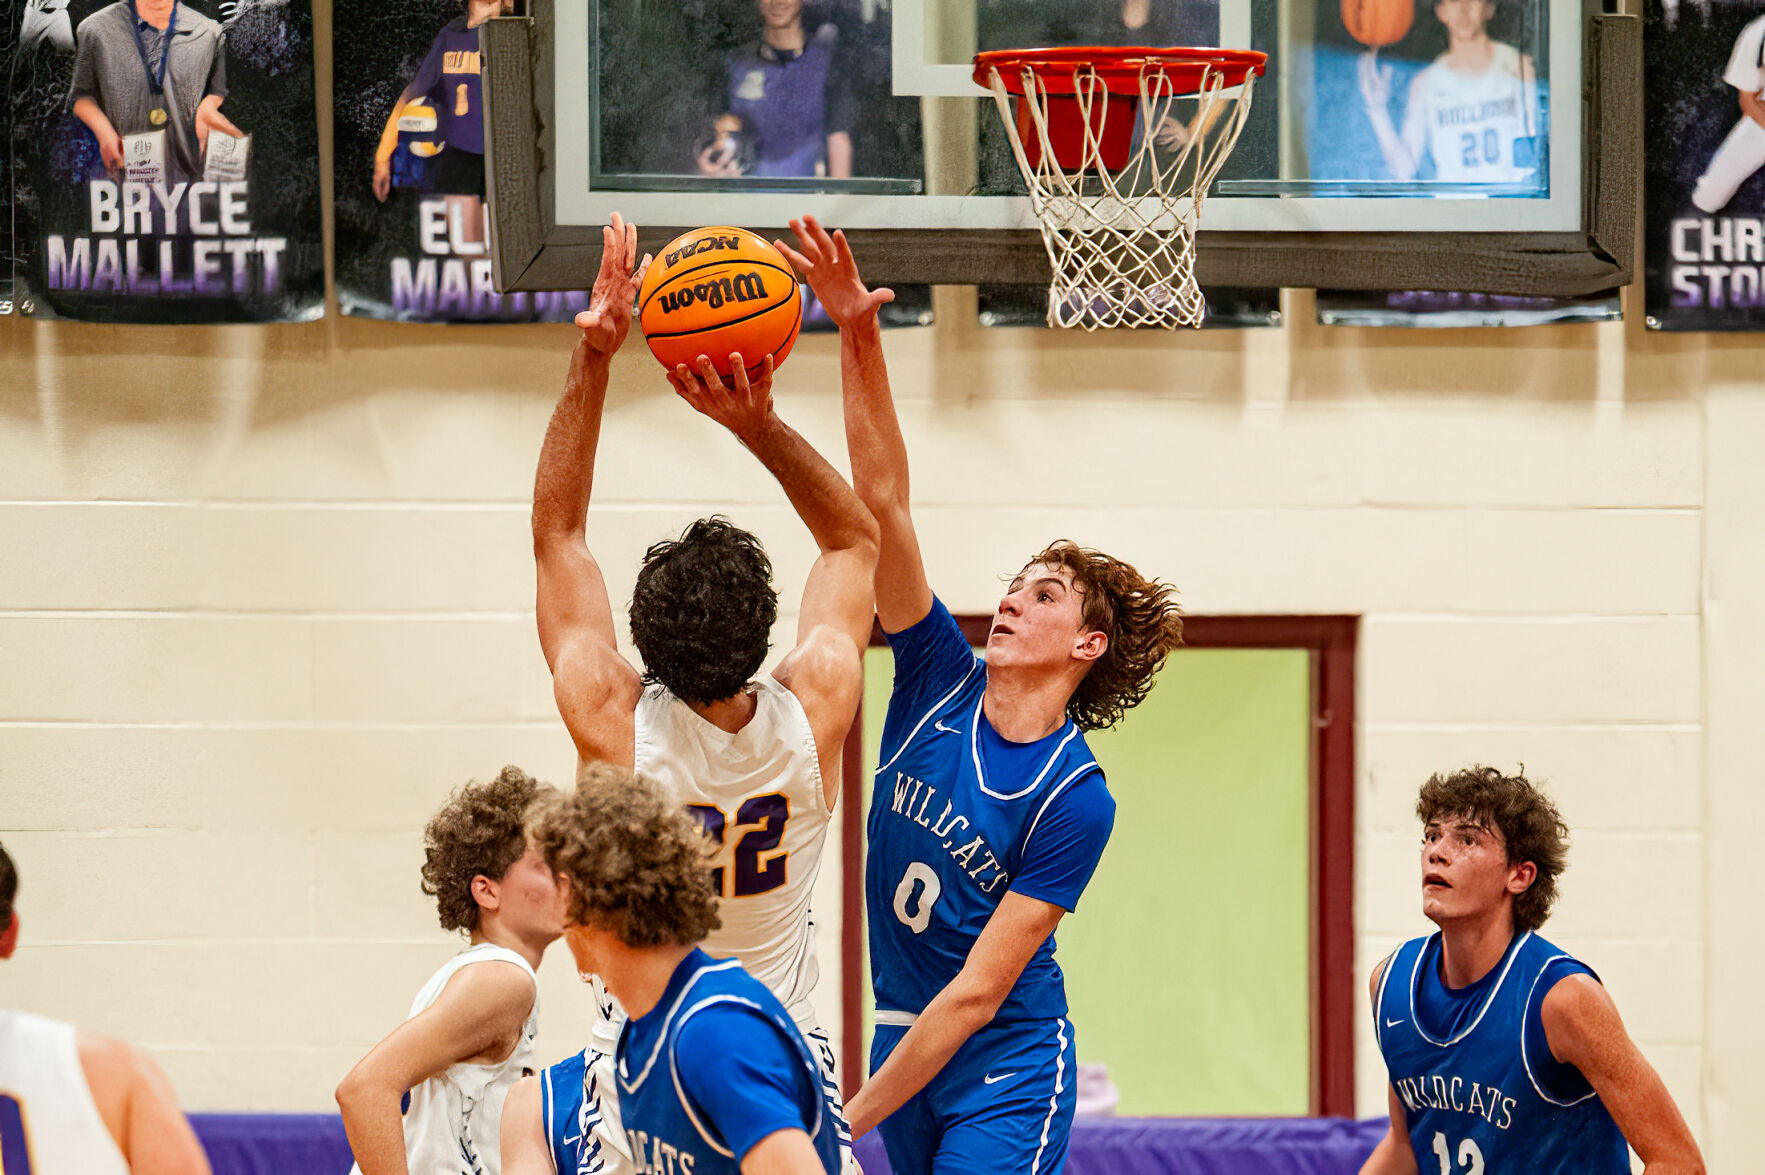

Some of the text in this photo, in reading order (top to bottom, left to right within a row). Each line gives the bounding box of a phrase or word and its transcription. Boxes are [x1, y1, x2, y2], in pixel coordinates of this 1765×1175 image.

[1461, 129, 1500, 168] 20
[89, 180, 250, 235] BRYCE
[47, 235, 287, 295] MALLETT
[664, 235, 741, 269] NCAA
[1671, 216, 1765, 263] CHR
[390, 256, 592, 314] MAR
[656, 271, 769, 315] Wilson
[1671, 265, 1765, 308] STO
[891, 771, 1009, 893] WILDCATS
[893, 861, 942, 935] 0
[1397, 1075, 1517, 1130] WILDCATS
[1432, 1131, 1485, 1175] 12
